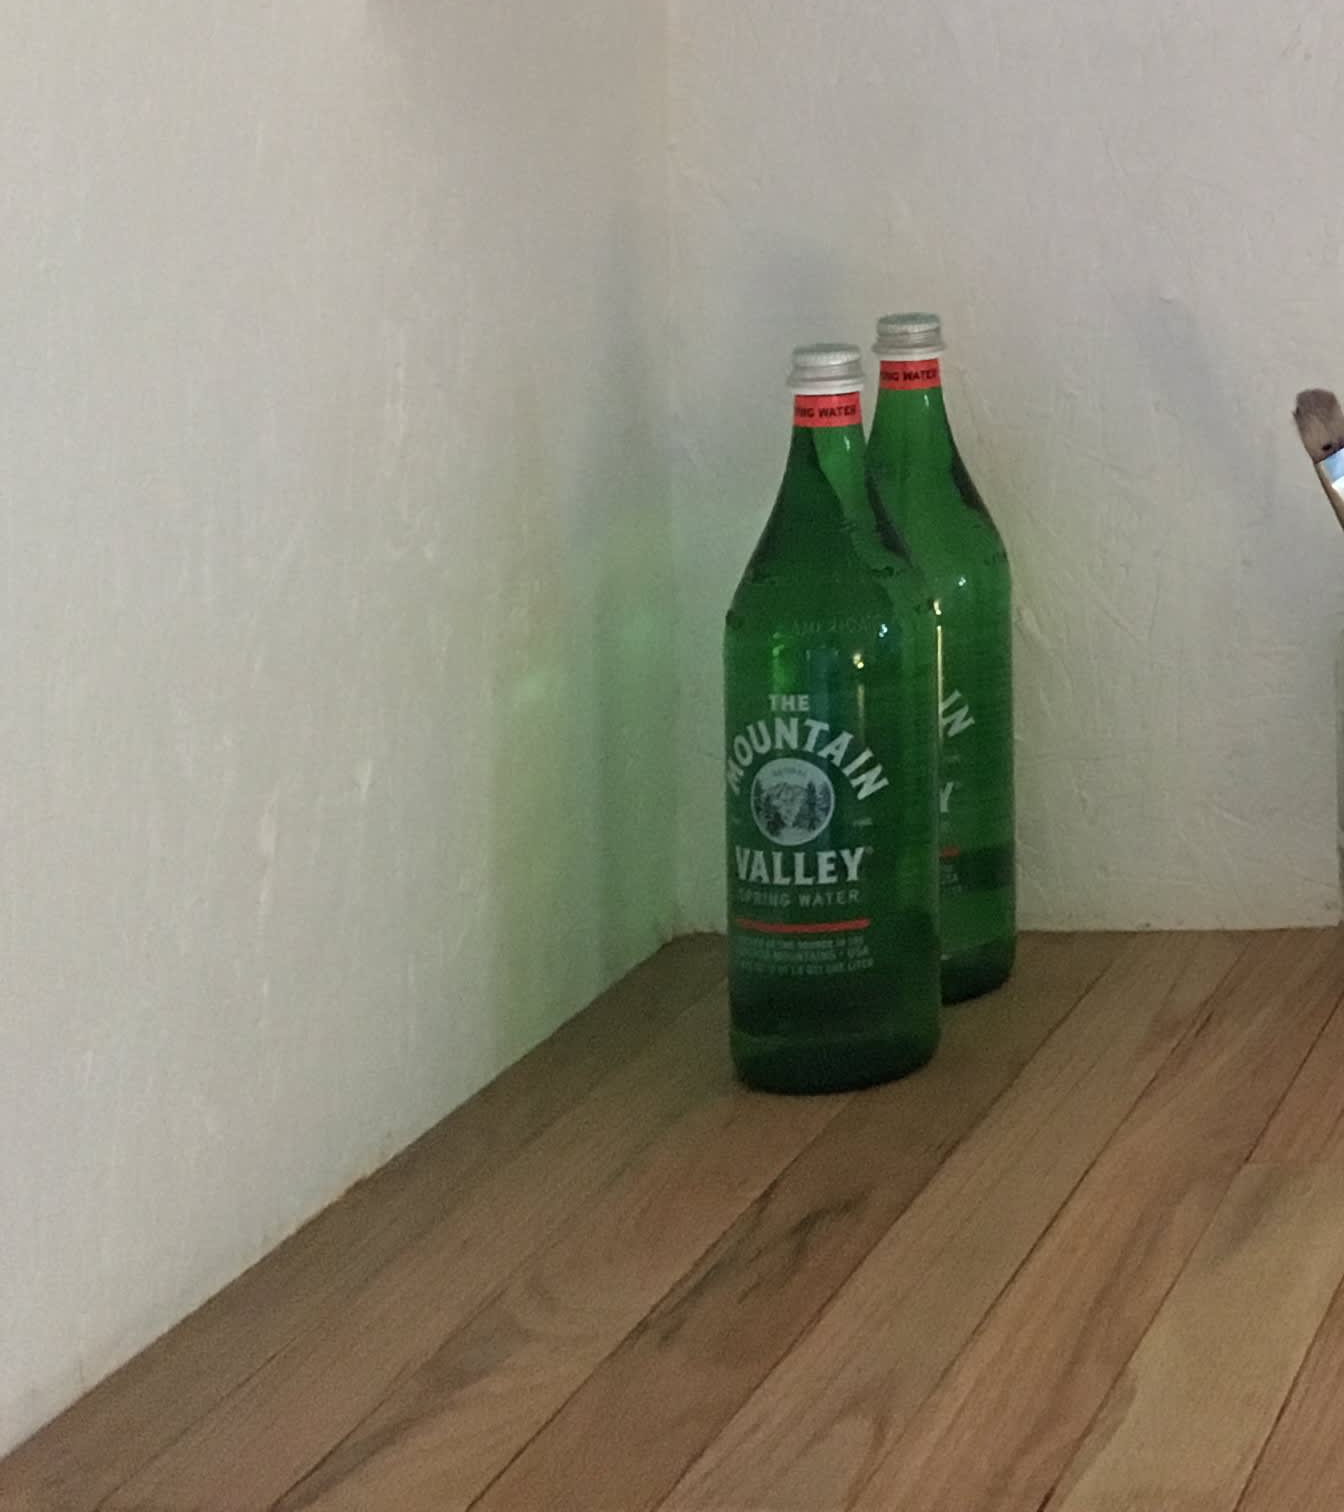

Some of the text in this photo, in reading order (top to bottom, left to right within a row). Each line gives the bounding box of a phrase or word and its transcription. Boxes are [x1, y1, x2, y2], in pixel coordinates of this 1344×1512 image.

[818, 404, 857, 419] WATER
[768, 693, 810, 712] THE
[727, 716, 889, 801] MOUNTAIN
[735, 845, 865, 886] VALLEY
[799, 888, 860, 906] WATER
